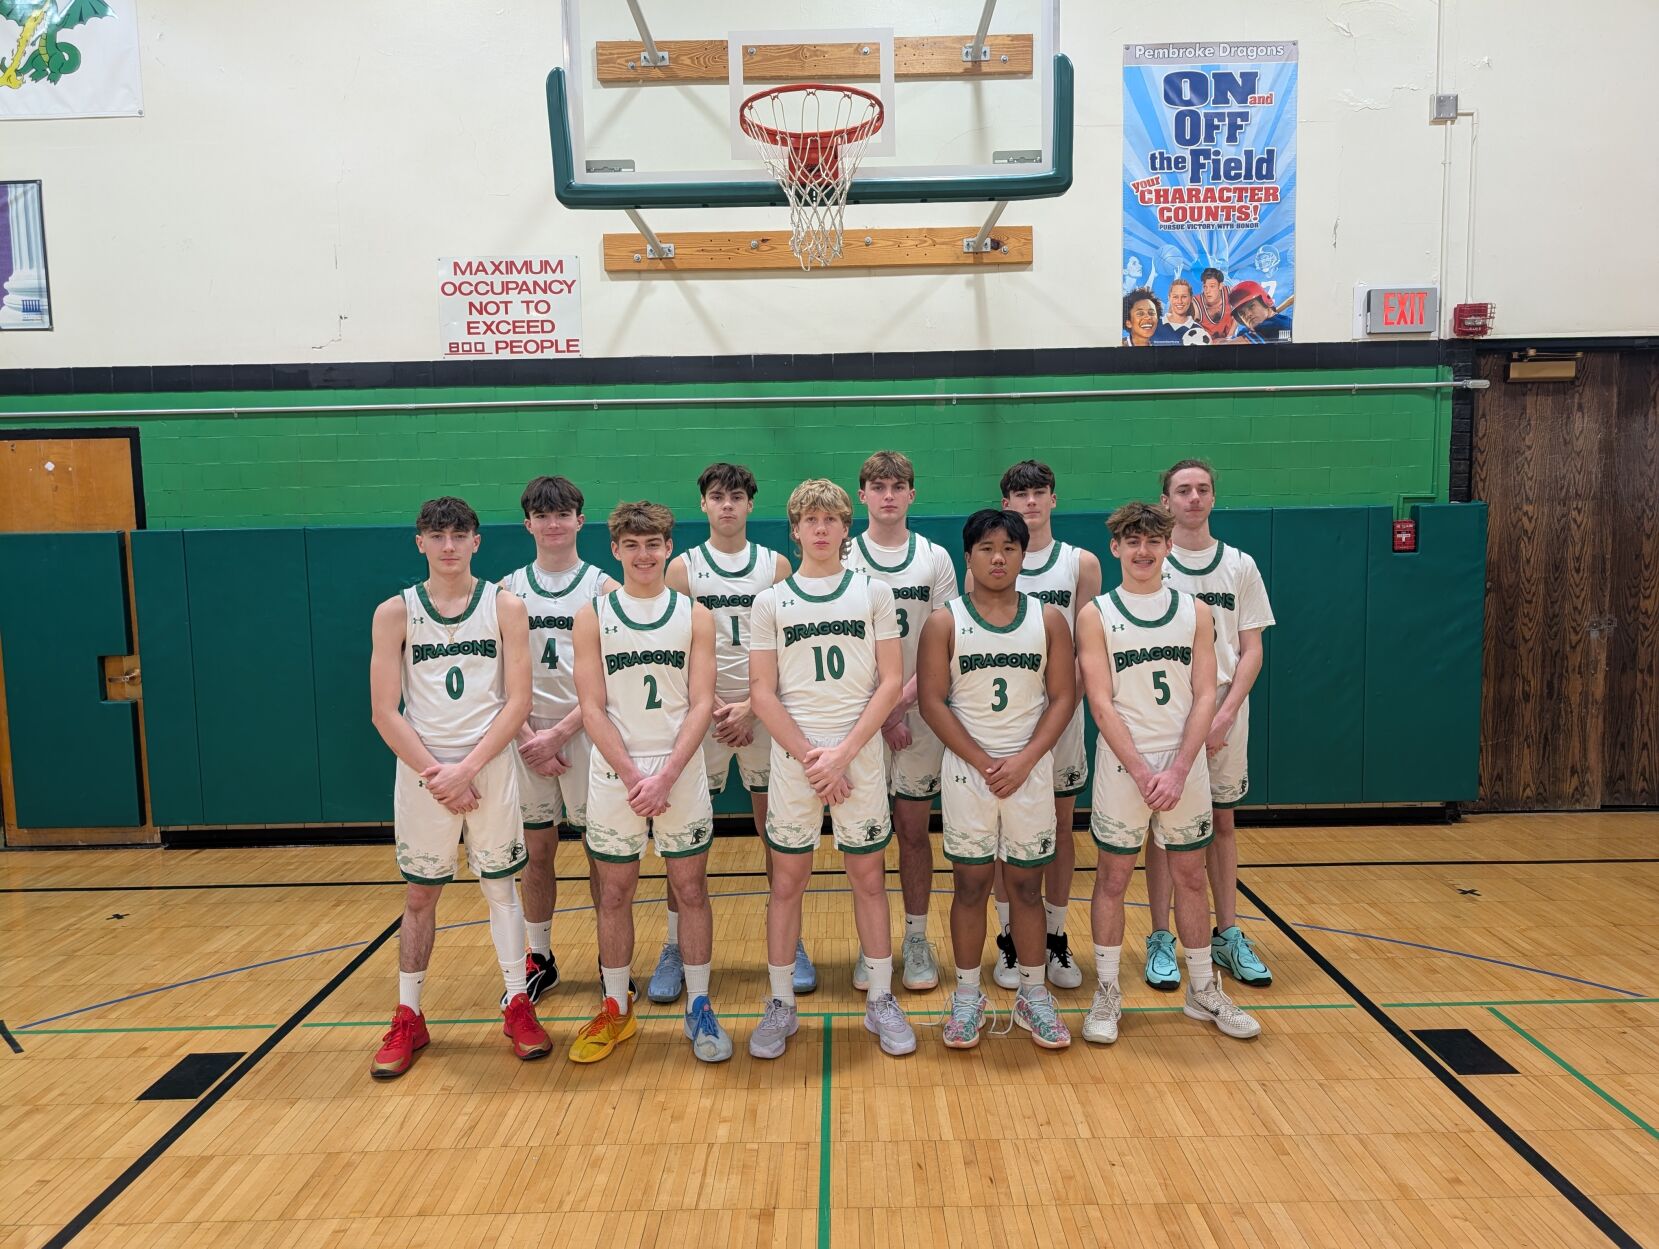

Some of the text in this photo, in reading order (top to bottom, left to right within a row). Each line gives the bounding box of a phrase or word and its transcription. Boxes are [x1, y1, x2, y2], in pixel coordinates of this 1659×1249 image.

[1135, 44, 1284, 60] Pembroke Dragons
[1163, 71, 1273, 108] ON and
[1174, 109, 1249, 147] OFF
[1149, 149, 1276, 184] the Field
[1131, 176, 1160, 193] your
[1139, 186, 1280, 205] CHARACTER
[1158, 205, 1260, 223] COUNTS!
[453, 259, 563, 276] MAXIMUM
[440, 279, 576, 296] OCCUPANCY
[468, 299, 551, 315] NOT TO
[1383, 292, 1428, 326] EXIT
[466, 319, 556, 335] EXCEED
[448, 338, 580, 355] 800 PEOPLE
[730, 615, 741, 646] 1
[783, 620, 865, 647] DRAGONS
[895, 608, 910, 638] 3
[412, 639, 497, 665] DRAGONS
[541, 637, 559, 670] 4
[605, 650, 686, 675] DRAGONS
[811, 645, 845, 682] 10
[959, 653, 1042, 675] DRAGONS
[1113, 646, 1191, 673] DRAGONS
[445, 666, 465, 700] 0
[643, 674, 662, 710] 2
[991, 677, 1008, 712] 3
[1152, 670, 1171, 706] 5
